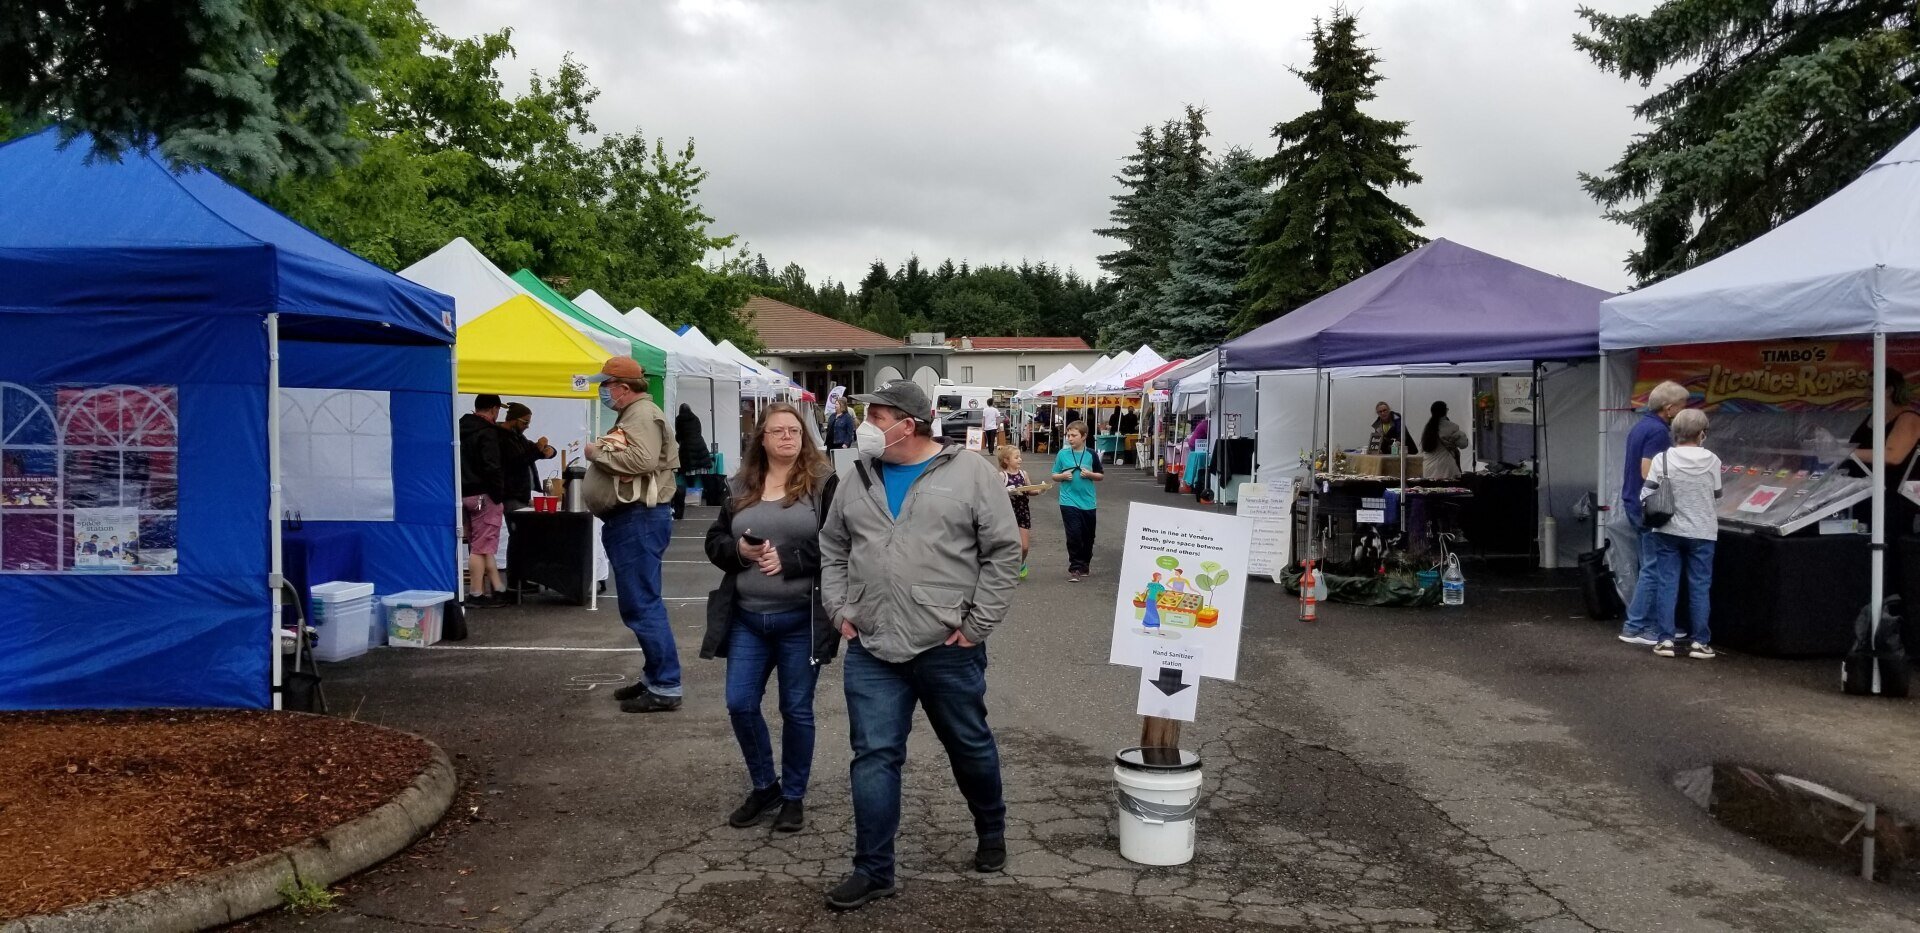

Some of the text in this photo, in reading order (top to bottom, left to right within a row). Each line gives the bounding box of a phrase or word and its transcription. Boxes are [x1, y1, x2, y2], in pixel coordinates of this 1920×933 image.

[1761, 347, 1826, 362] TIMBO'S
[1708, 364, 1869, 402] Licorice Ropes
[76, 520, 102, 529] space
[1142, 526, 1159, 534] When
[1188, 533, 1214, 541] Vendors
[1139, 544, 1165, 552] yourself
[1178, 549, 1201, 557] others!
[1141, 535, 1161, 543] Booth,
[1162, 538, 1176, 546] give
[1196, 543, 1223, 551] between
[1152, 649, 1194, 660] Hand Sanitizer
